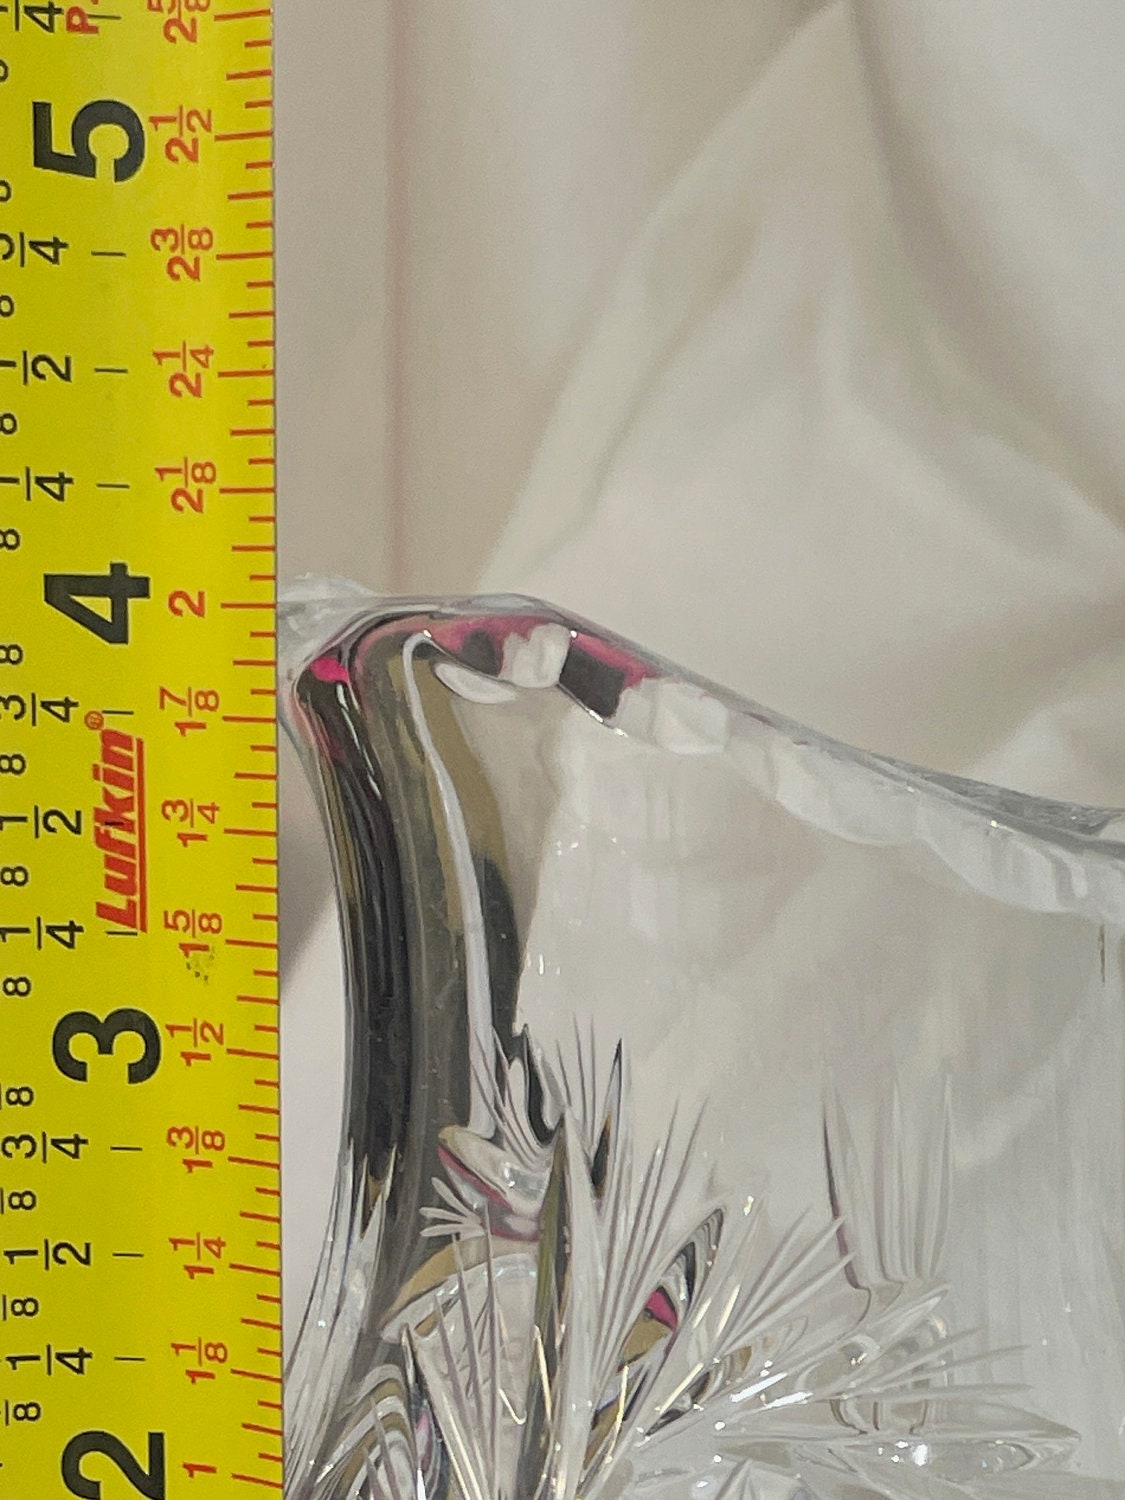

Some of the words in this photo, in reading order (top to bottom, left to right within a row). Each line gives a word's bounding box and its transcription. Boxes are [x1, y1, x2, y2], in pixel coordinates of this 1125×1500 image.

[33, 100, 145, 182] 5
[44, 561, 150, 645] 4
[168, 590, 205, 617] 2
[52, 1007, 162, 1085] 3
[183, 1462, 216, 1478] 1
